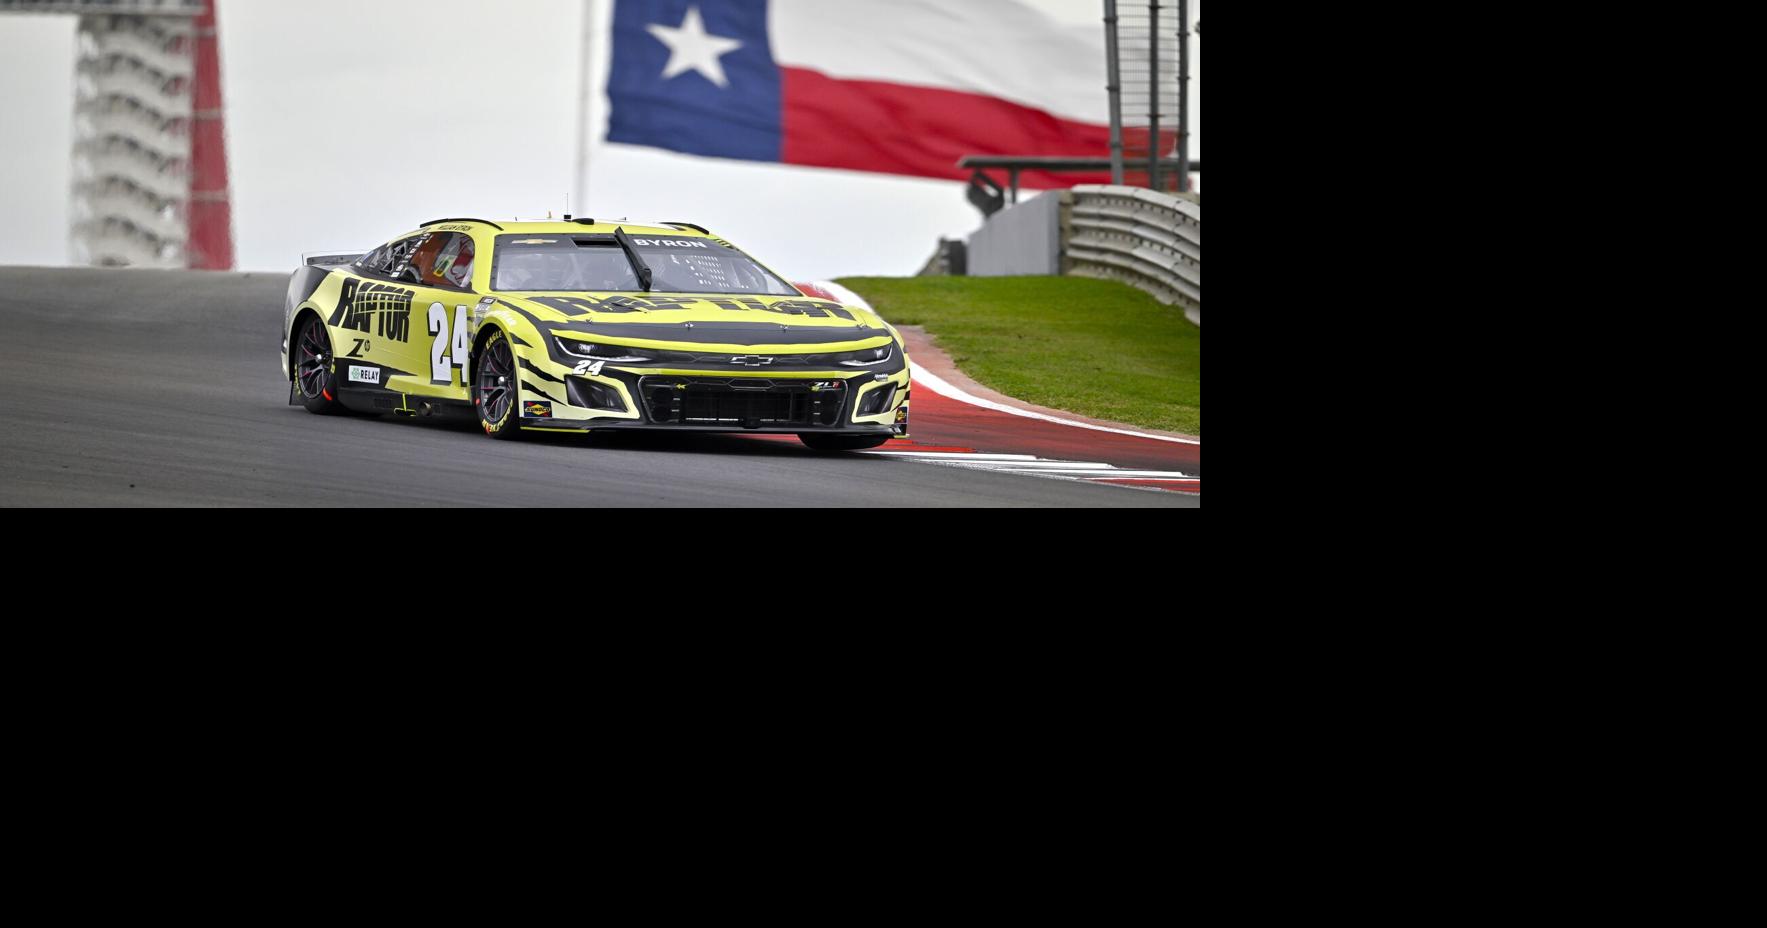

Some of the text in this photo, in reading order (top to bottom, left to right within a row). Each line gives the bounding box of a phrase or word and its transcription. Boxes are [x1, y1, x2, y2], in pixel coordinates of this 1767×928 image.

[633, 239, 708, 248] BYRON
[328, 277, 415, 343] RAPTOR
[427, 302, 468, 387] 24
[361, 369, 379, 381] RELAY
[572, 360, 605, 376] 24
